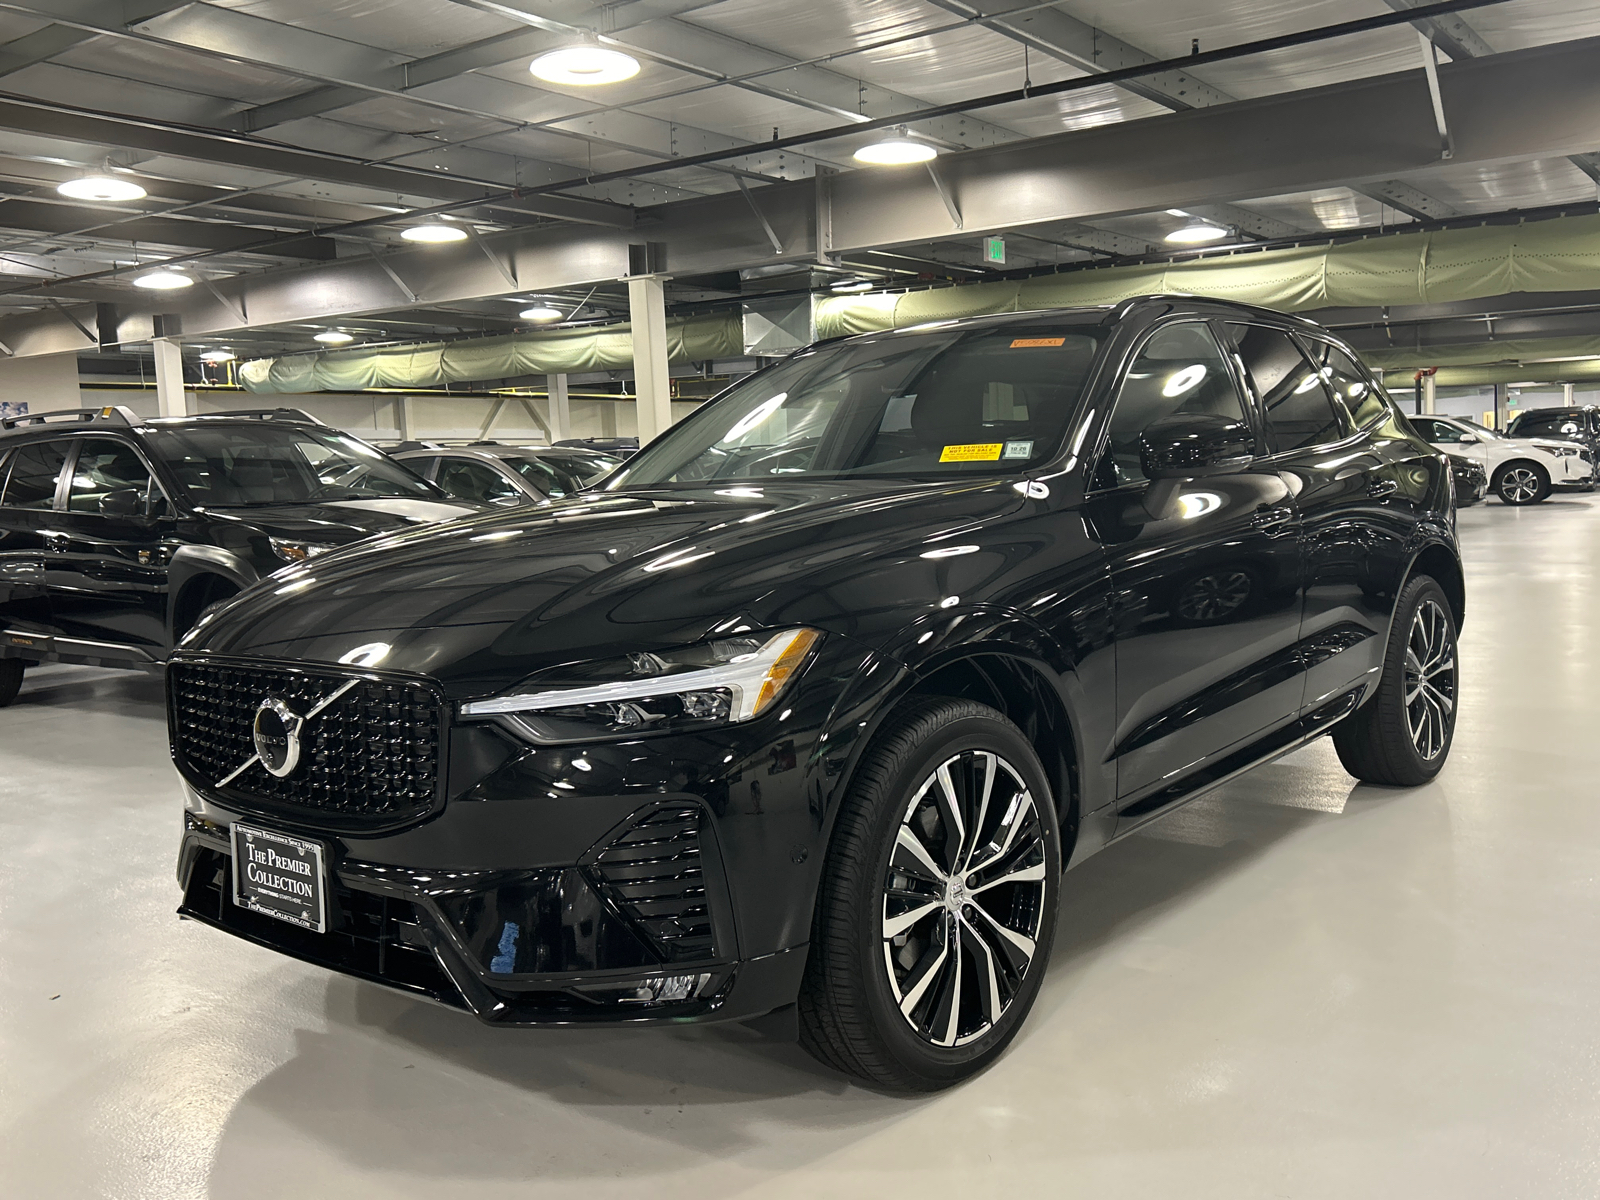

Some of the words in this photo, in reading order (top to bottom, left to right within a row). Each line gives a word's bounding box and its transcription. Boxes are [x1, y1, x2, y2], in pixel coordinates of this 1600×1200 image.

[256, 733, 286, 745] VOLVO
[267, 848, 312, 877] PREMIER
[247, 862, 313, 898] COLLECTION
